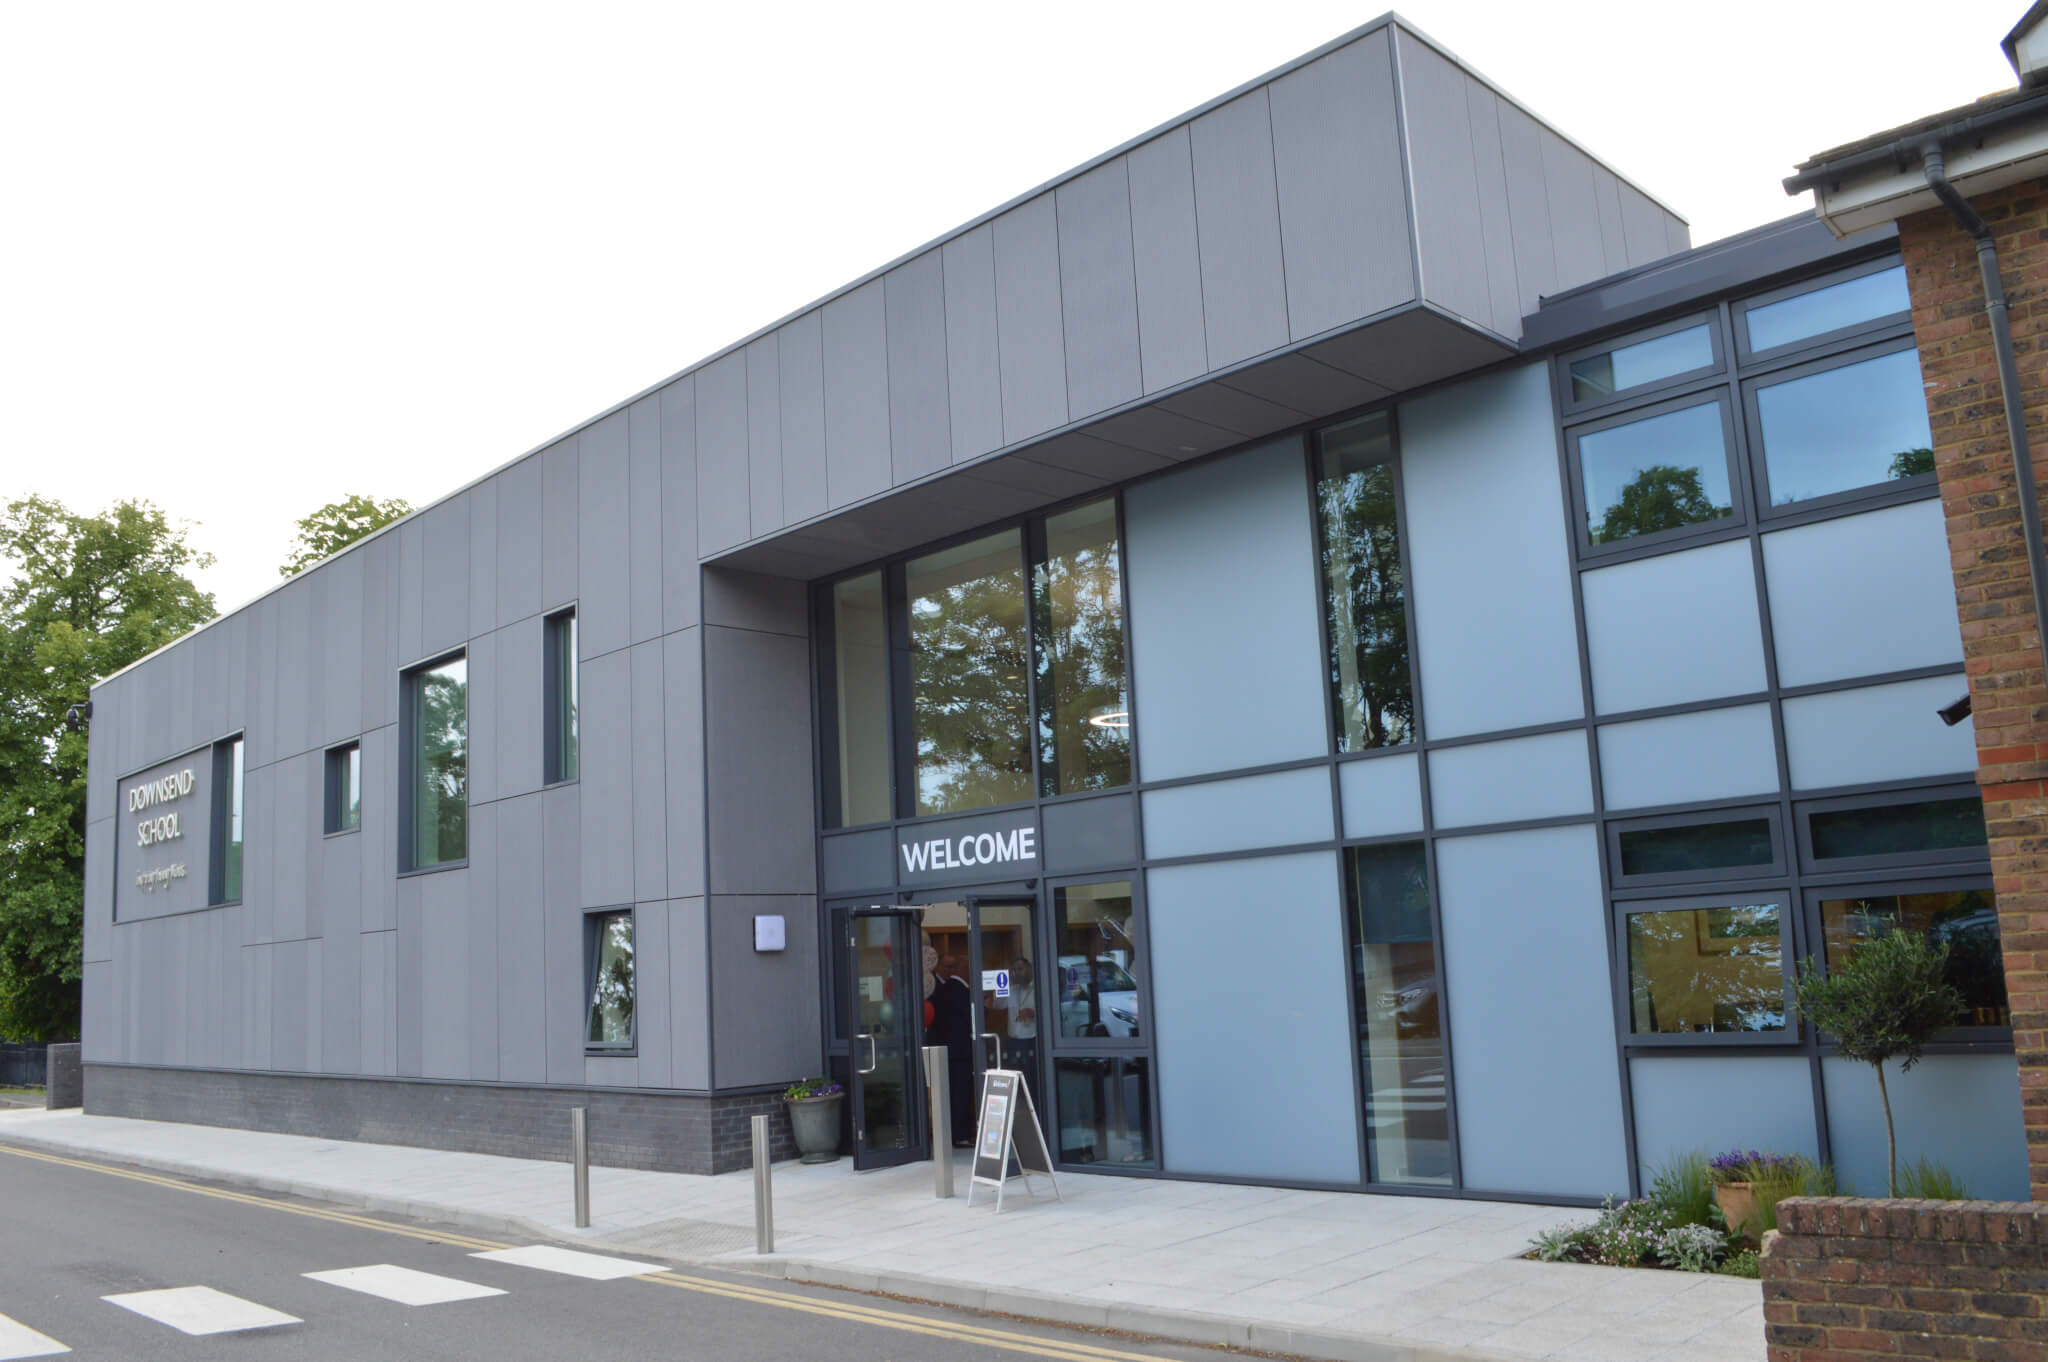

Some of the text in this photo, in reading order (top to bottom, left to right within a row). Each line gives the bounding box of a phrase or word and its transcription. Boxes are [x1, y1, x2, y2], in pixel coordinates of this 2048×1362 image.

[129, 769, 193, 812] DOWNSEND
[137, 812, 182, 847] SCHOOL
[902, 827, 1036, 873] WELCOME
